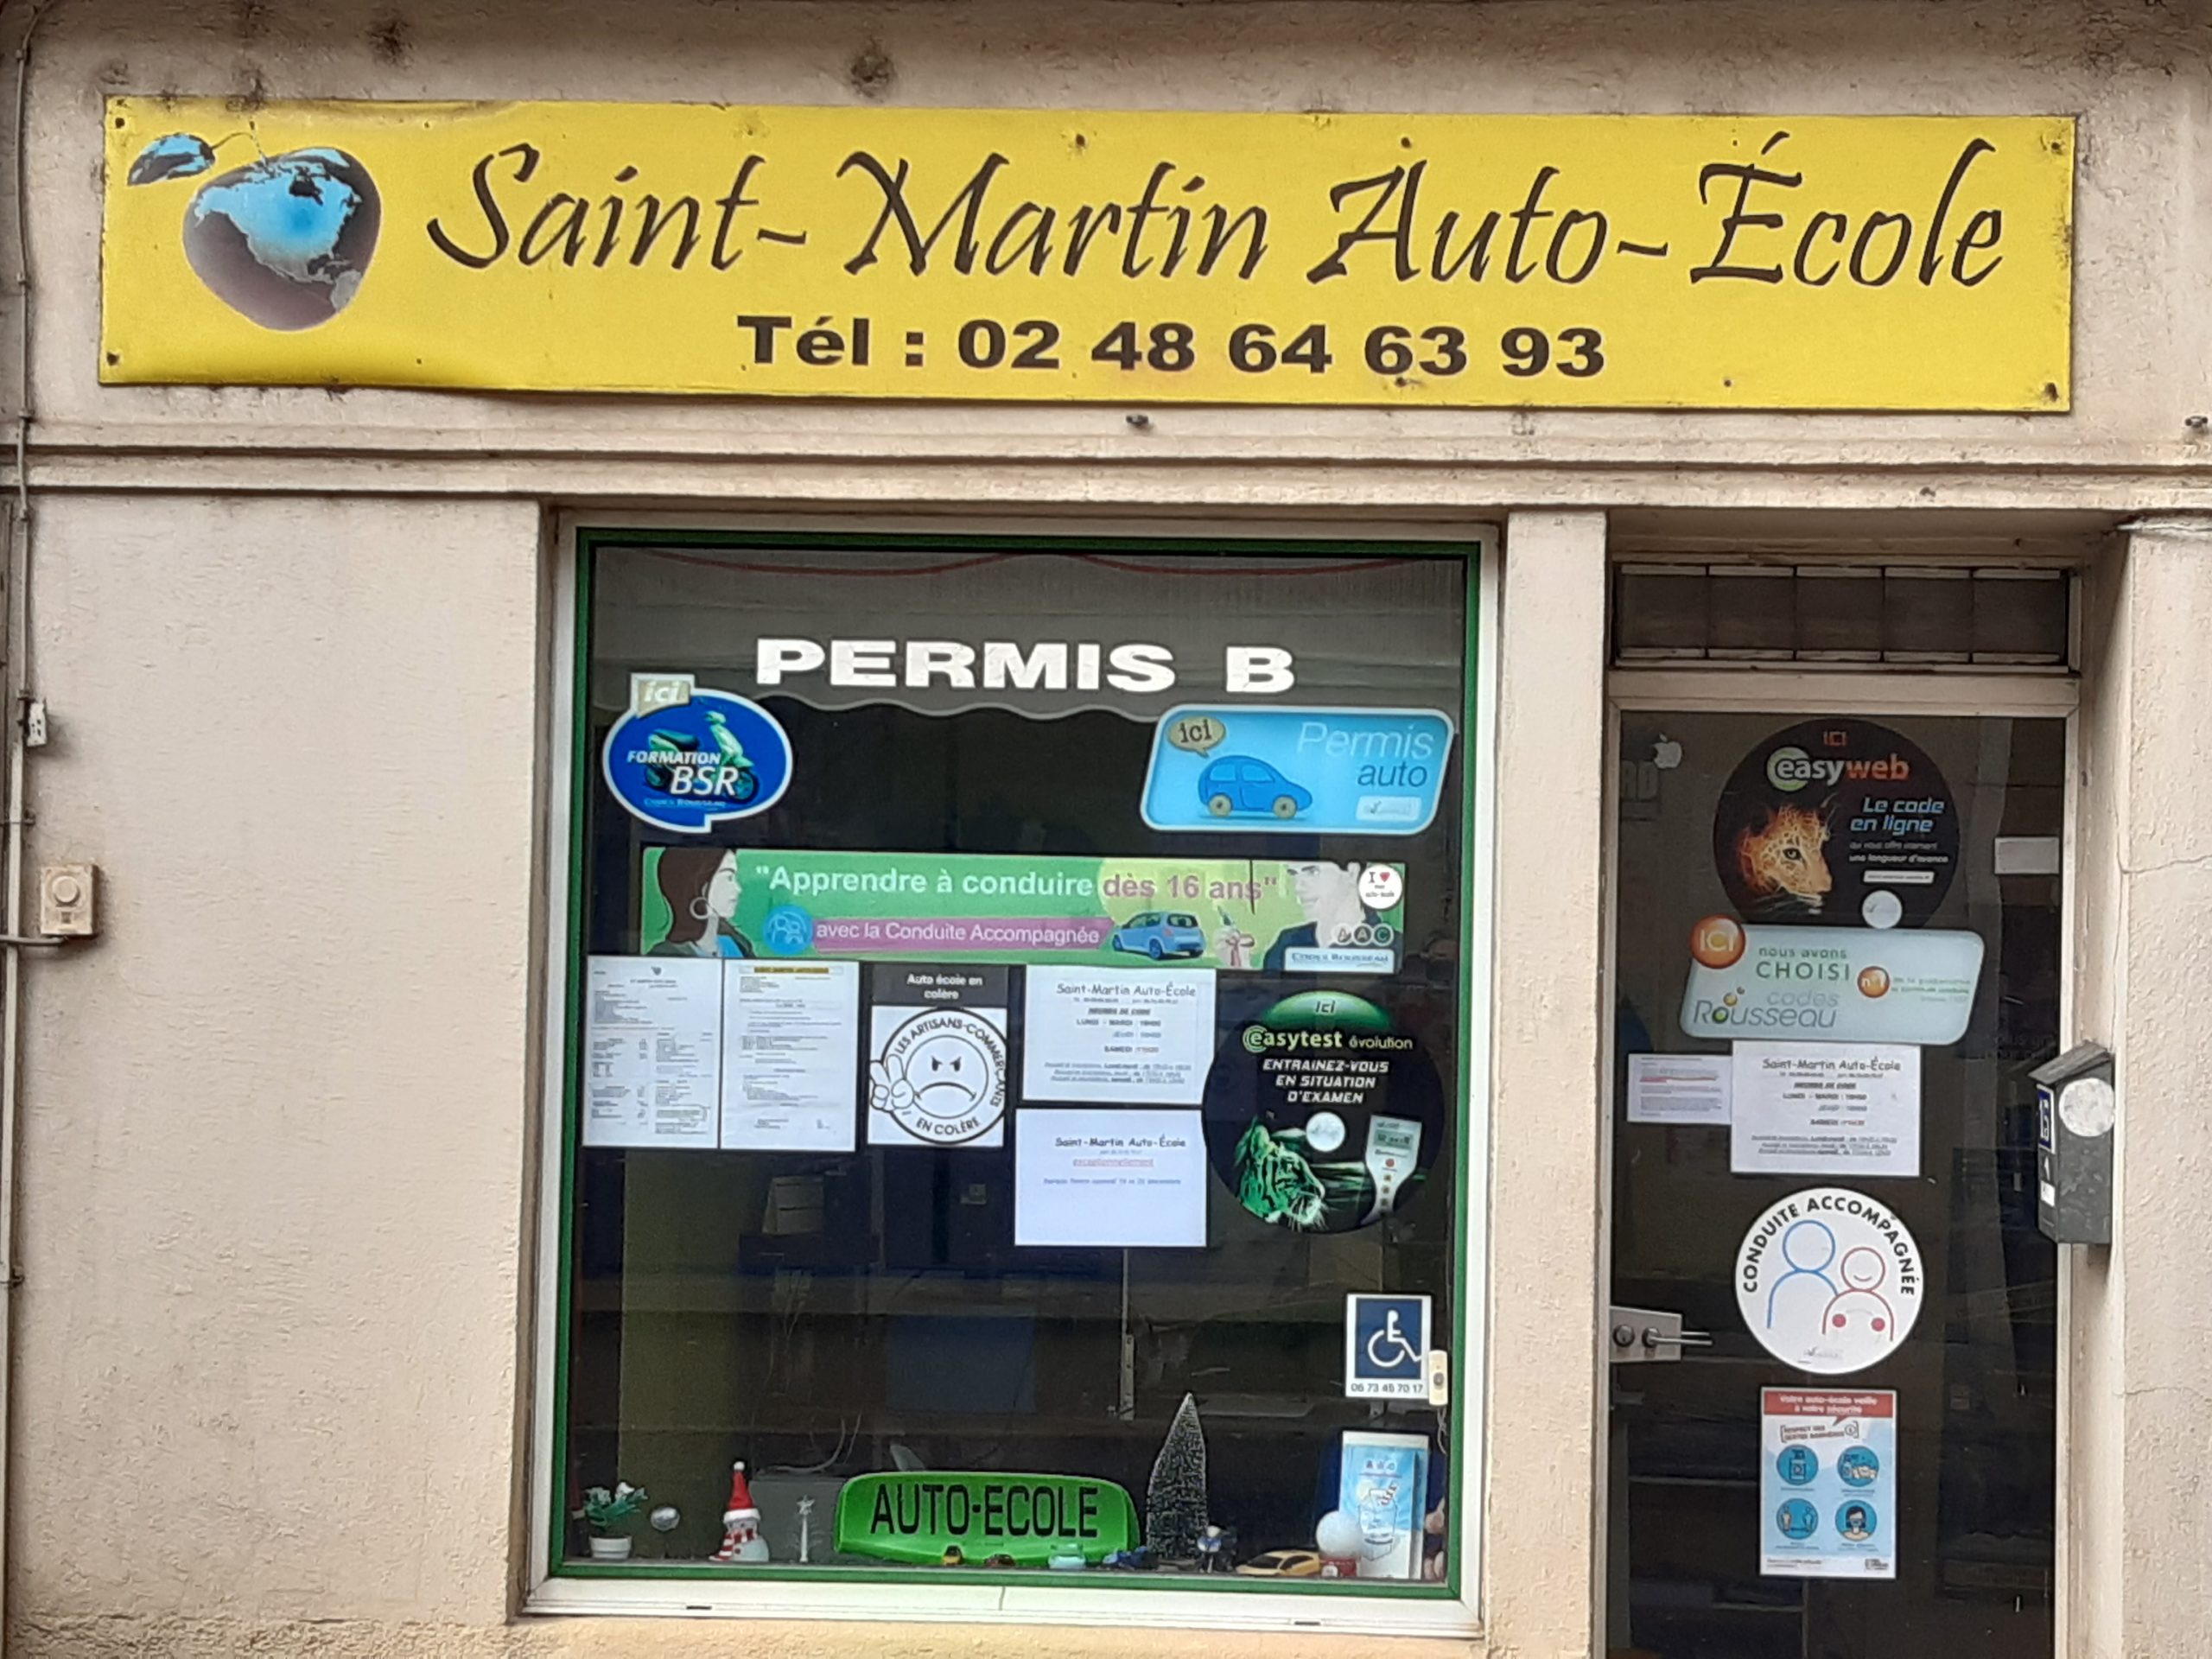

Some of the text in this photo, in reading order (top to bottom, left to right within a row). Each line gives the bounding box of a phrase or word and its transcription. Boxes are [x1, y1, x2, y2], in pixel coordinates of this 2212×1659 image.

[1306, 130, 2003, 287] Auto-École
[738, 315, 869, 365] Tél
[957, 319, 1060, 369] 02
[1091, 322, 1194, 371] 48
[1228, 324, 1331, 374] 64
[1364, 324, 1466, 375] 63
[1501, 326, 1605, 378] 93
[756, 639, 1295, 693] PERMIS B
[645, 681, 682, 702] ici
[1179, 718, 1212, 743] ici
[1298, 721, 1434, 760] Permis
[1823, 732, 1847, 747] ICI
[627, 750, 721, 765] FORMATION
[1357, 762, 1427, 787] auto
[1777, 753, 1910, 786] easyweb
[670, 766, 739, 796] BSR
[1863, 797, 1944, 813] Le code
[1850, 815, 1934, 836] en ligne
[937, 870, 951, 893] à
[963, 872, 1093, 897] conduire
[1103, 873, 1155, 898] dès
[1167, 874, 1200, 898] 16
[817, 922, 1100, 947] avec la Conduite Accompagnée
[1700, 929, 1735, 952] ICI
[1758, 948, 1847, 959] nous avons
[907, 974, 982, 986] Auto école en
[1756, 961, 1850, 980] CHOISI
[1766, 991, 1840, 1007] codes
[1693, 999, 1837, 1028] Rousseau
[894, 1036, 912, 1054] LES
[1262, 1058, 1389, 1073] ENTRAINEZ-VOUS
[1275, 1075, 1376, 1089] EN SITUATION
[1287, 1090, 1364, 1103] D'EXAMEN
[916, 1116, 980, 1135] EN COLÈRE
[1743, 1196, 1919, 1295] CONDUITE ACCOMPAGNÉE
[870, 1484, 1098, 1538] AUTO-ECOLE
